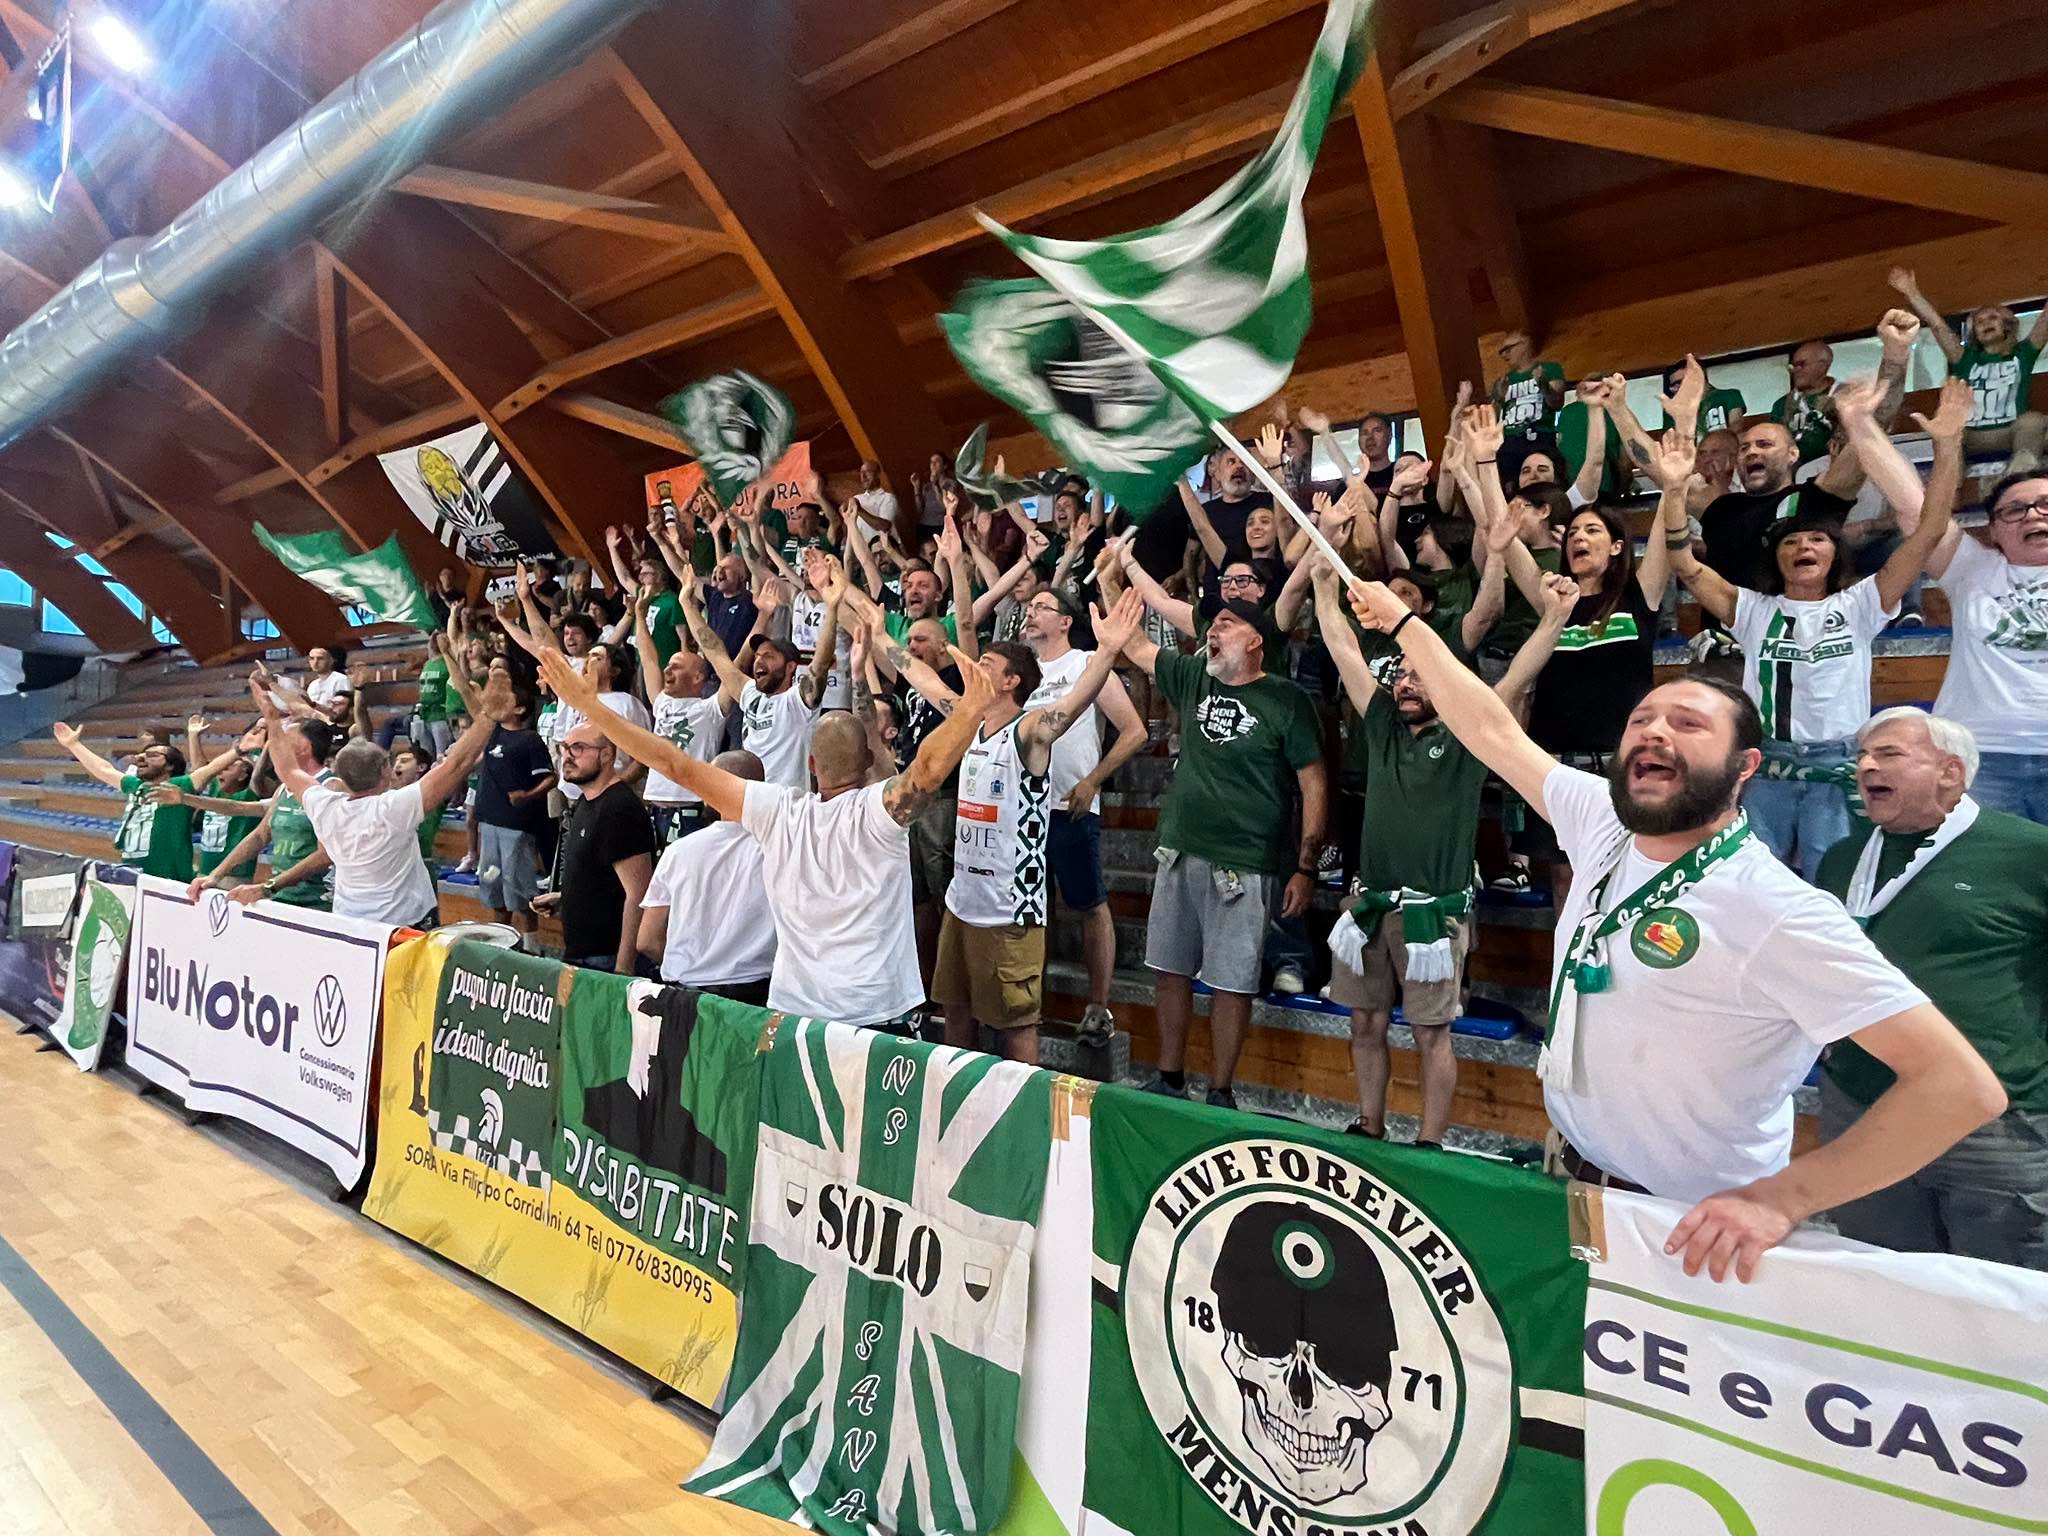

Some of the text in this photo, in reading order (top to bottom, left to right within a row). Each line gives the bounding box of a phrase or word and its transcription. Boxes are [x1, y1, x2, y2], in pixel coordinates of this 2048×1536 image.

[447, 966, 554, 1024] pugni in faccia
[433, 1018, 484, 1066] ideali
[485, 1042, 492, 1068] e
[299, 1065, 353, 1104] Volkswagen
[404, 1143, 437, 1170] SORA
[440, 1160, 459, 1182] Via
[462, 1168, 501, 1202] Filippo
[564, 1217, 581, 1240] 64
[585, 1224, 602, 1252] Tel
[605, 1237, 713, 1304] 0776/830995
[816, 1183, 942, 1298] SOLO
[1154, 1144, 1476, 1317] LIVE FOREVER
[1184, 1295, 1216, 1334] 18
[1400, 1365, 1443, 1411] 71
[1719, 1371, 1772, 1420] e
[1804, 1382, 2028, 1488] GAS
